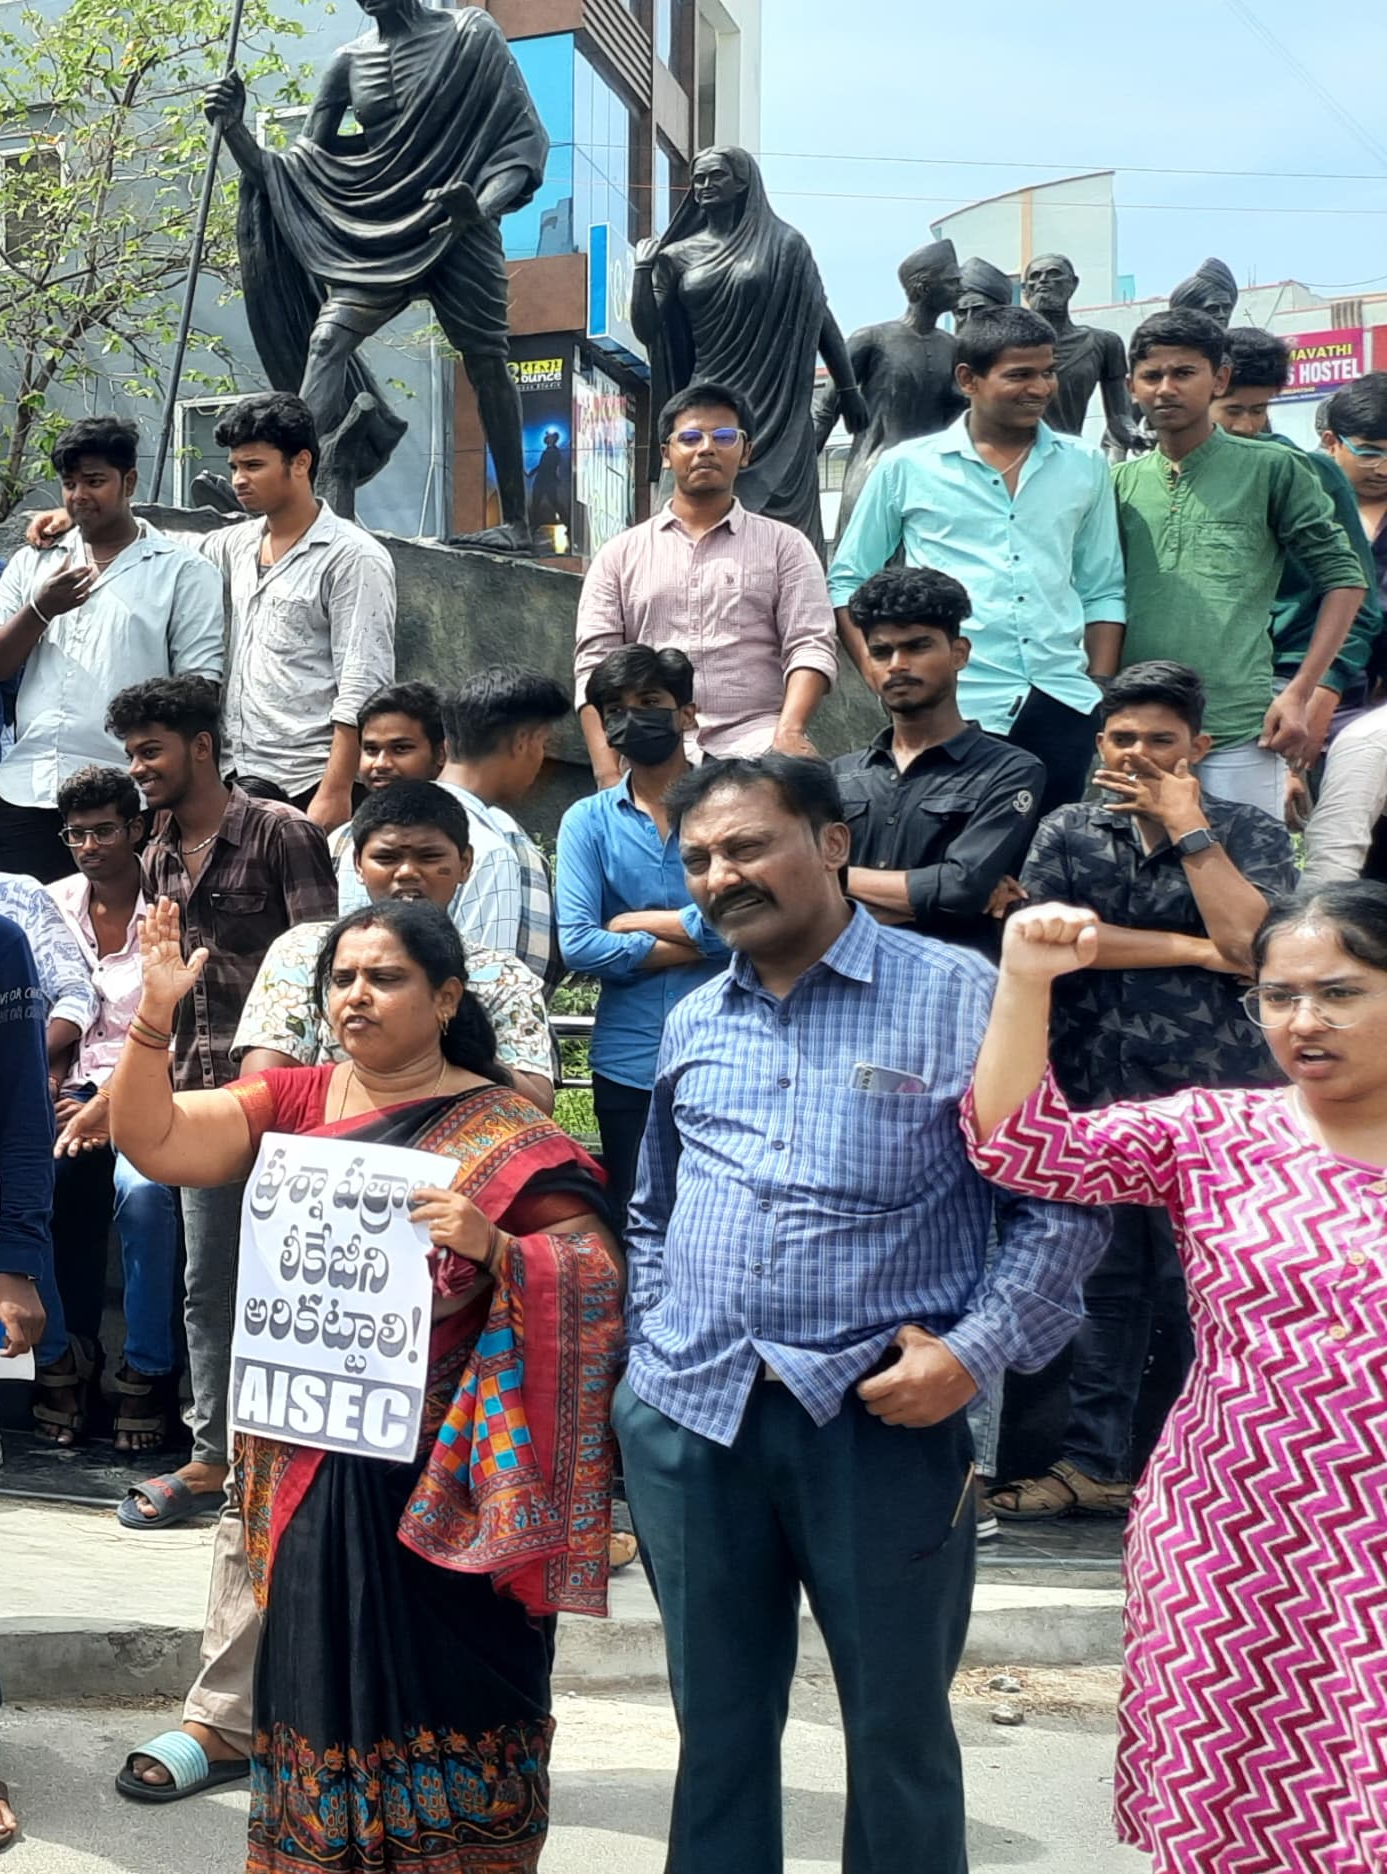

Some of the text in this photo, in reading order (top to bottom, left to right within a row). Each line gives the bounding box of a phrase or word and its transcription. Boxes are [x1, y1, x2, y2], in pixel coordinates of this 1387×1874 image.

[521, 372, 562, 384] ounce
[1299, 358, 1362, 384] HOSTEL
[279, 1222, 389, 1294] లీకేజీని
[243, 1293, 422, 1374] అరికట్టాలి!
[236, 1364, 412, 1449] AISEC
